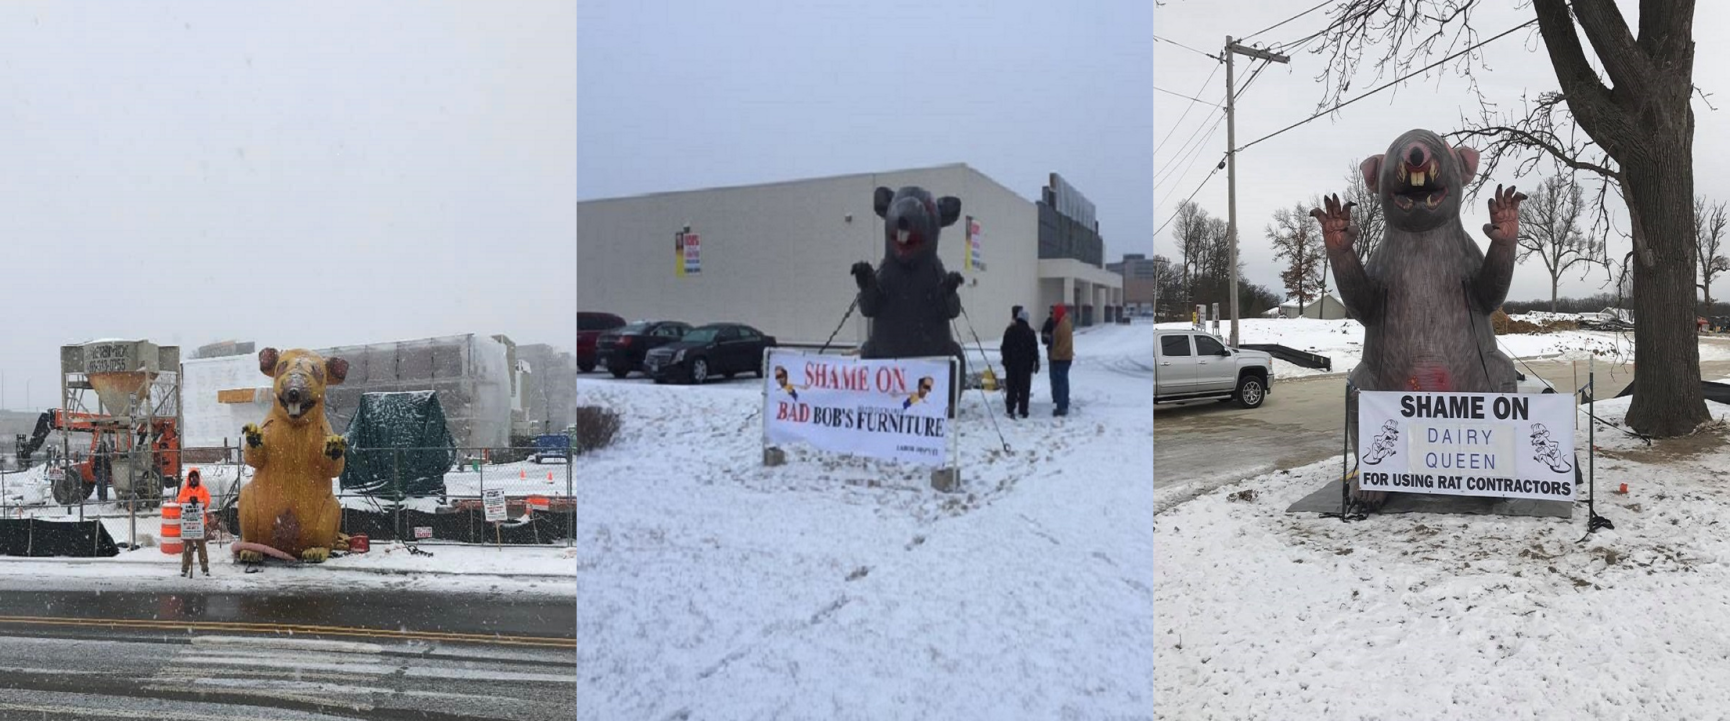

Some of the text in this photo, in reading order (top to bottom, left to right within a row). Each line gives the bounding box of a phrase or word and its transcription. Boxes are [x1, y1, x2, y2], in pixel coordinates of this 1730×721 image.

[804, 361, 907, 393] SHAME ON
[776, 401, 810, 423] BAD
[813, 406, 854, 429] BOB'S
[857, 411, 945, 438] FURNITURE
[1400, 395, 1529, 420] SHAME ON
[1427, 428, 1493, 445] DAIRY
[1425, 452, 1496, 470] QUEEN
[1363, 472, 1572, 496] FOR USING RAT CONTRACTORS
